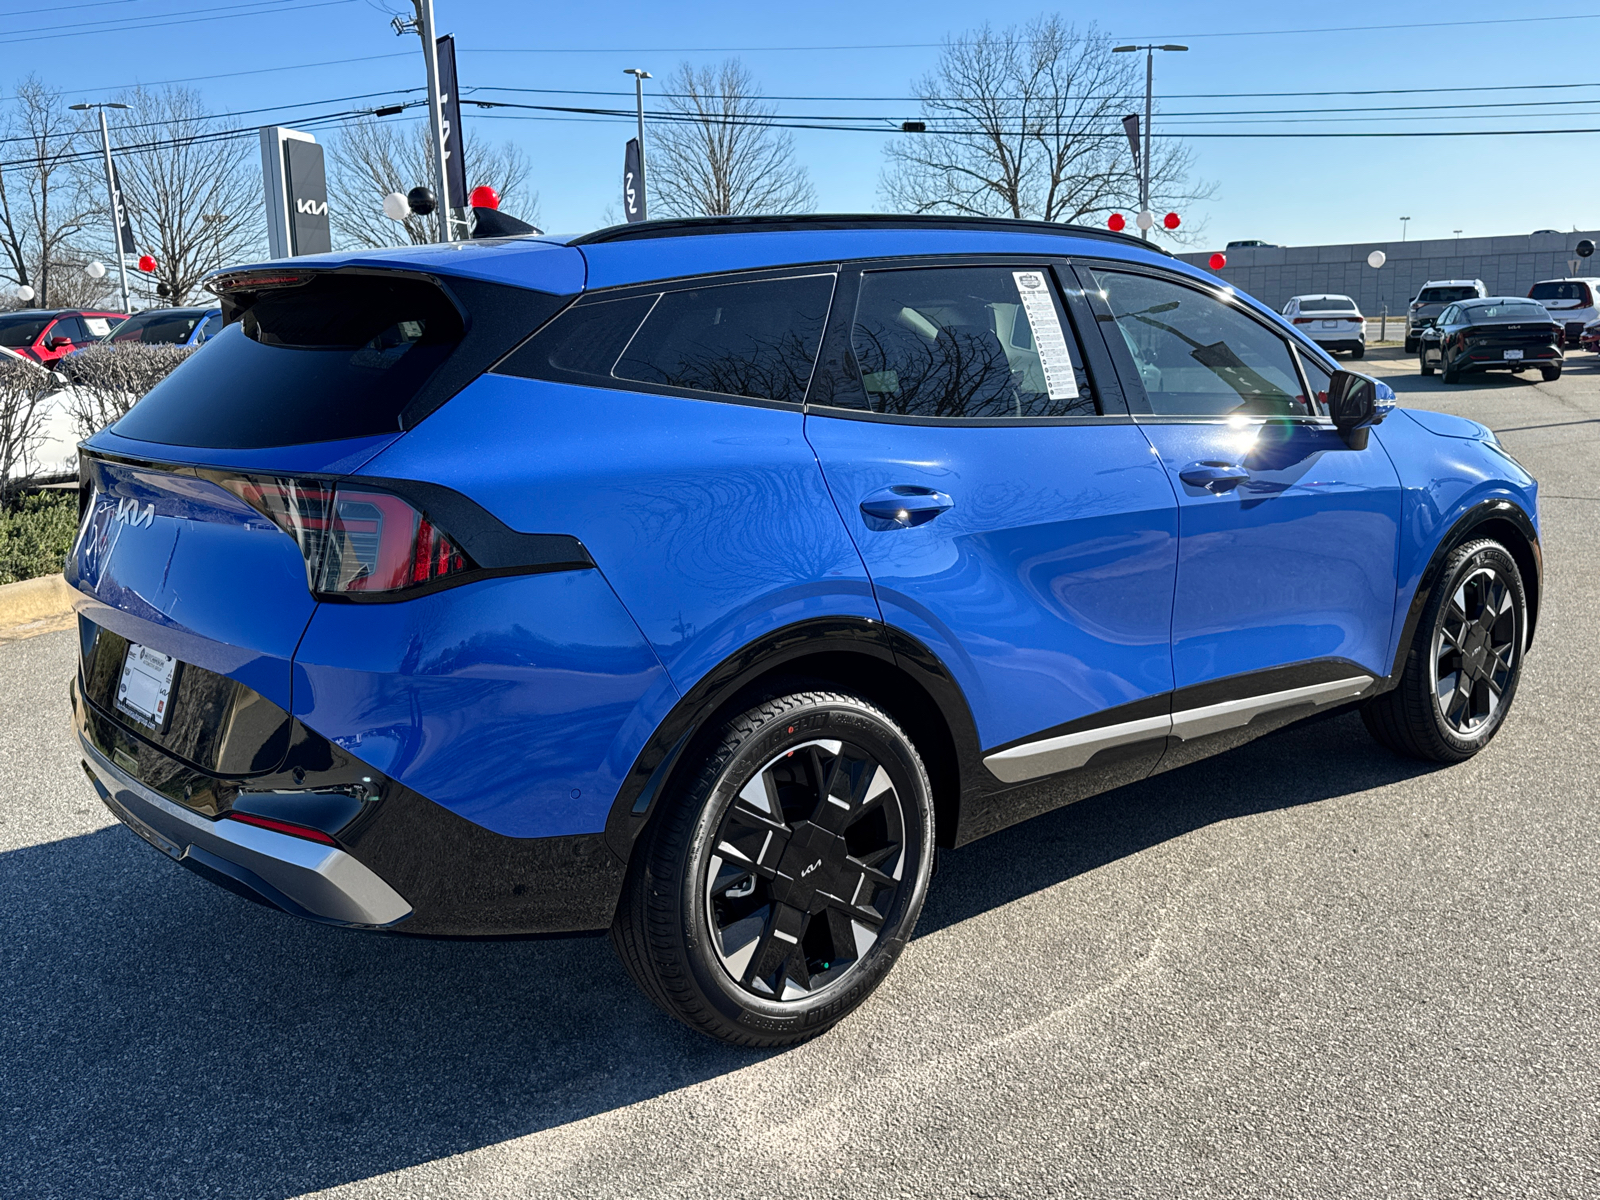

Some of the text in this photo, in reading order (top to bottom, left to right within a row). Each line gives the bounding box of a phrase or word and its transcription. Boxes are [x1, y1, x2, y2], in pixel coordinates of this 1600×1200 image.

[296, 198, 328, 216] KIA
[116, 497, 155, 530] KIA
[801, 859, 822, 877] KIA
